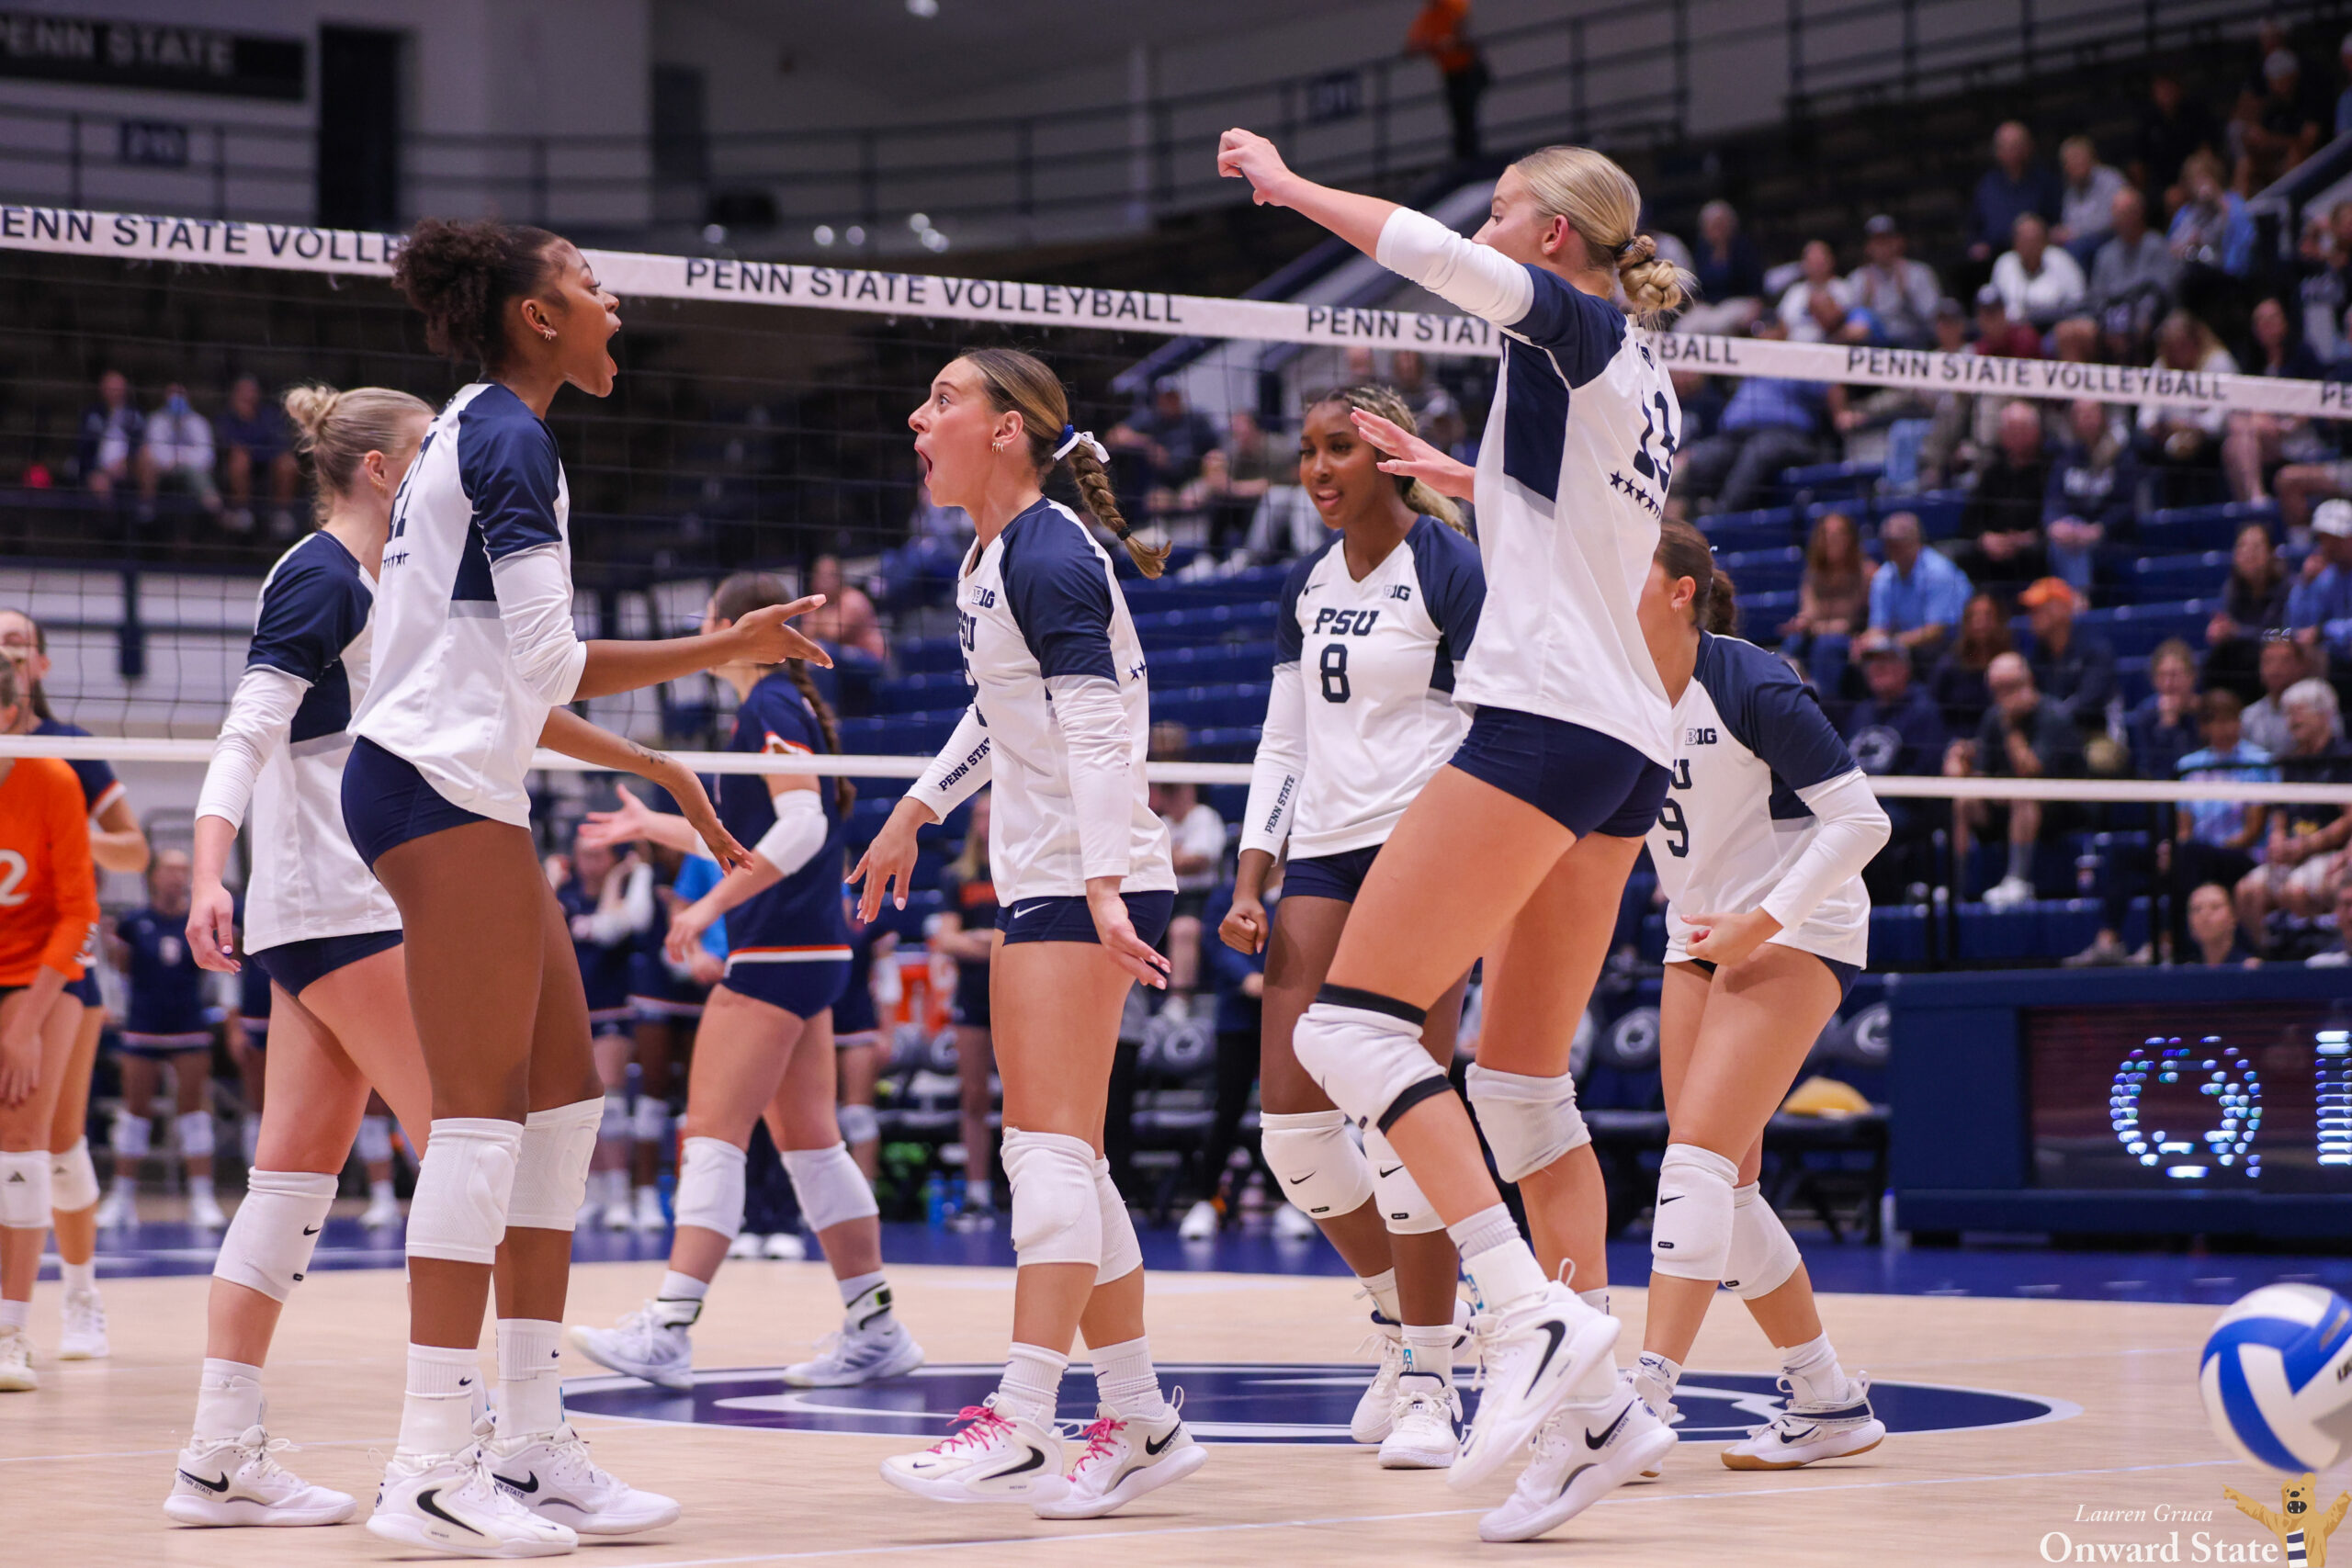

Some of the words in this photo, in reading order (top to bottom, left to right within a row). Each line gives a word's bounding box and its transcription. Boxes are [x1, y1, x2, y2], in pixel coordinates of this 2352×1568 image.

[0, 18, 94, 57] ENN
[107, 24, 232, 75] STATE
[2, 208, 94, 243] ENN
[113, 216, 248, 254] STATE
[686, 259, 793, 294] PENN
[810, 268, 926, 304] STATE
[943, 277, 1183, 322] VOLLEYBALL
[1307, 307, 1399, 338] PENN
[1415, 314, 1494, 345] STAT
[1847, 347, 1928, 378] PENN
[1942, 354, 2030, 388] STATE
[2043, 363, 2228, 401] VOLLEYBALL
[2321, 380, 2352, 409] PE
[1314, 607, 1380, 637] PSU
[1320, 643, 1351, 704] 8
[939, 761, 969, 792] PENN
[967, 737, 991, 766] STAT
[1264, 805, 1283, 834] PENN
[1277, 774, 1295, 807] STATE
[1658, 797, 1690, 858] 9
[195, 1483, 213, 1495] STATE
[503, 1485, 526, 1499] STATE
